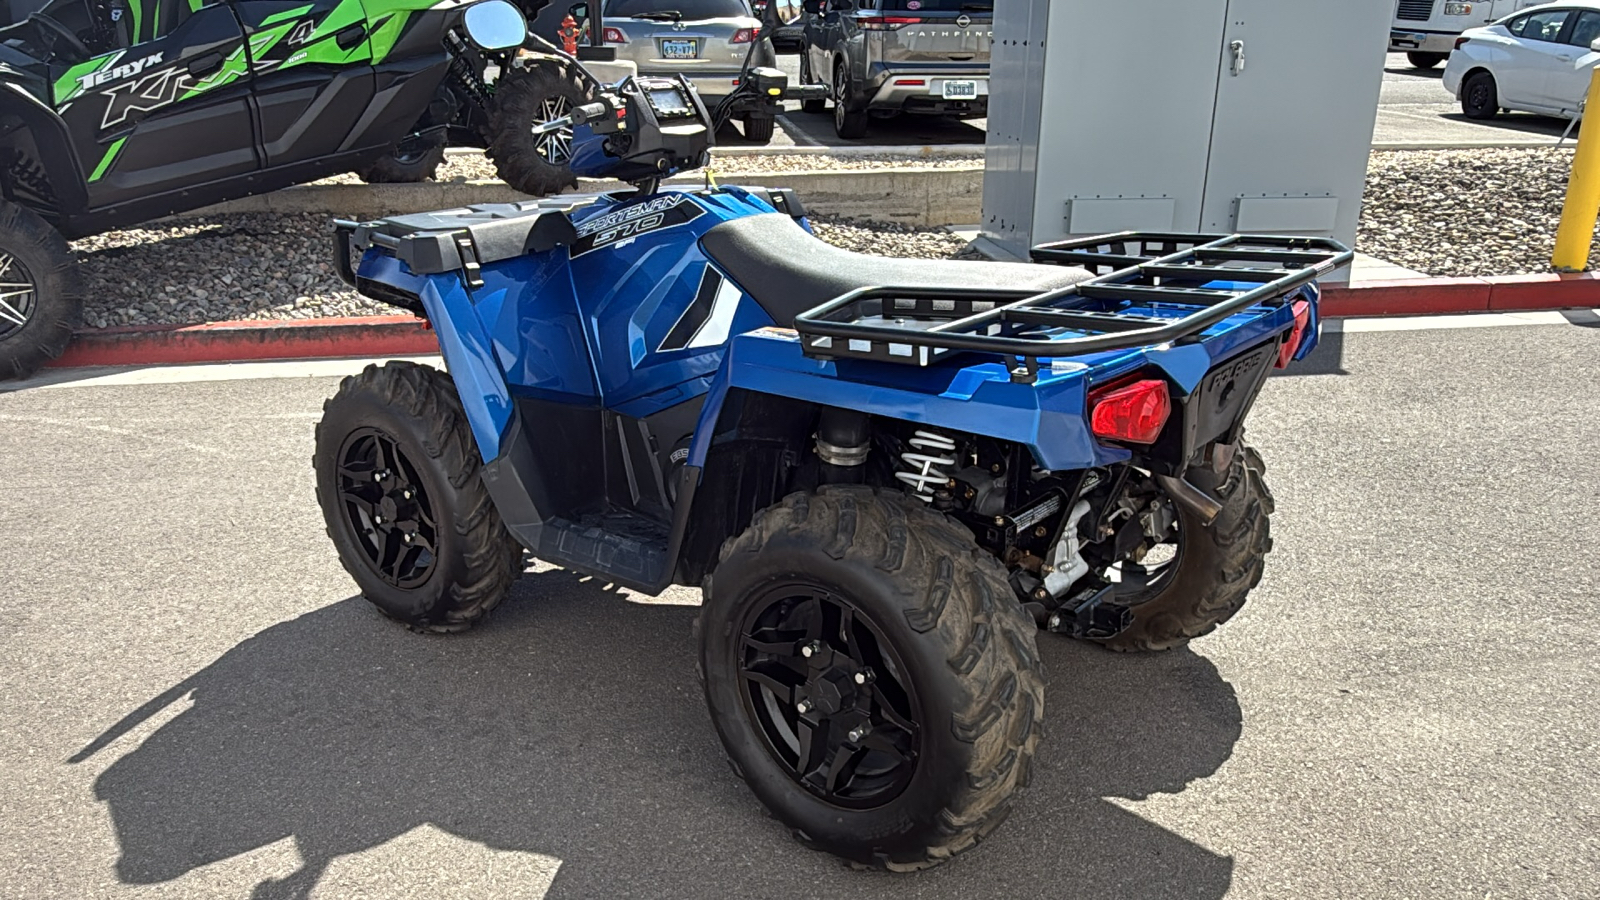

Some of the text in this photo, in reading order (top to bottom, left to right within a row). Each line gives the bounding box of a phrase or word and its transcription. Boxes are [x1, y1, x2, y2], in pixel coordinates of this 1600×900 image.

[287, 19, 317, 45] 4
[75, 51, 164, 90] TERYX
[287, 52, 308, 63] 1000
[592, 212, 665, 247] 570
